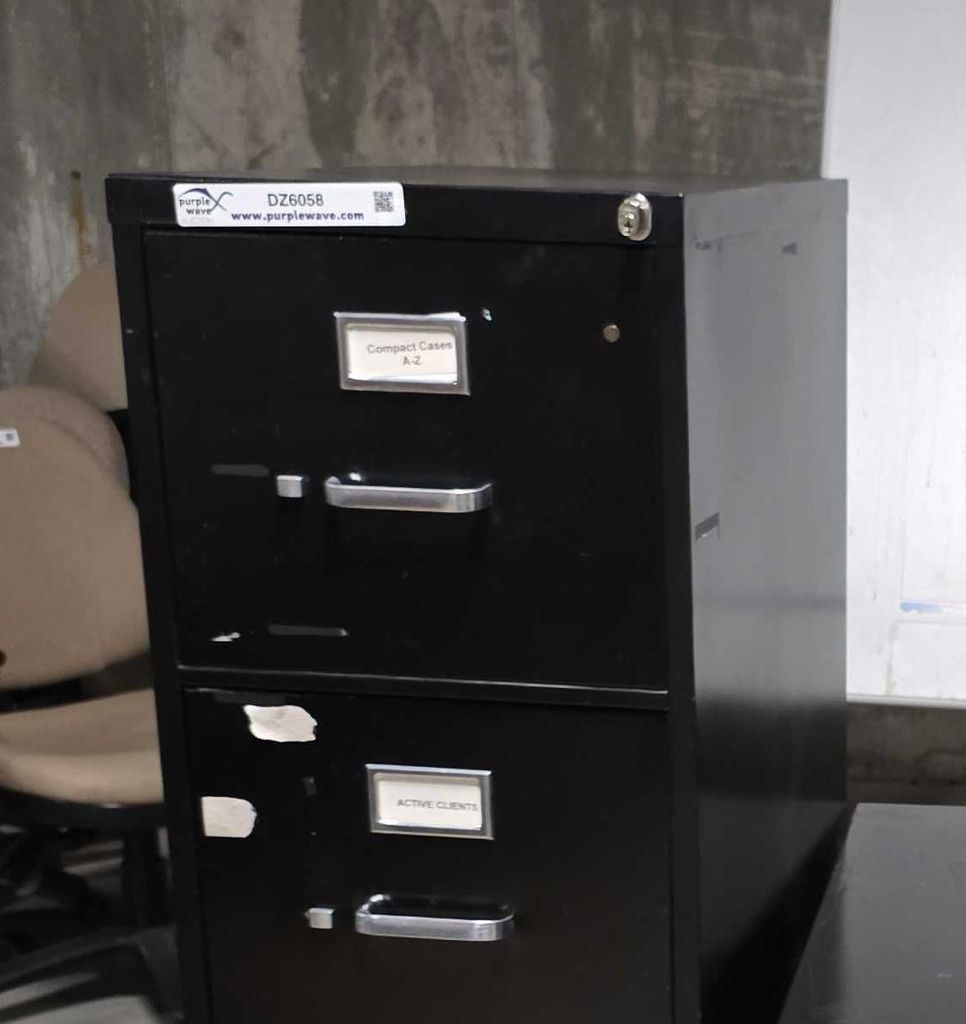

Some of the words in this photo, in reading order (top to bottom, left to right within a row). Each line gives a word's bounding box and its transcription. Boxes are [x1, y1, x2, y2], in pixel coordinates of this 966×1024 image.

[179, 197, 211, 207] purple
[267, 193, 324, 207] DZ6058
[186, 207, 212, 215] wave
[231, 210, 364, 222] www.purplewave.com
[367, 343, 416, 354] Compact
[420, 341, 453, 352] Cases
[402, 356, 422, 366] A-Z
[397, 799, 433, 809] ACTIVE
[436, 801, 478, 811] CLIENTS
